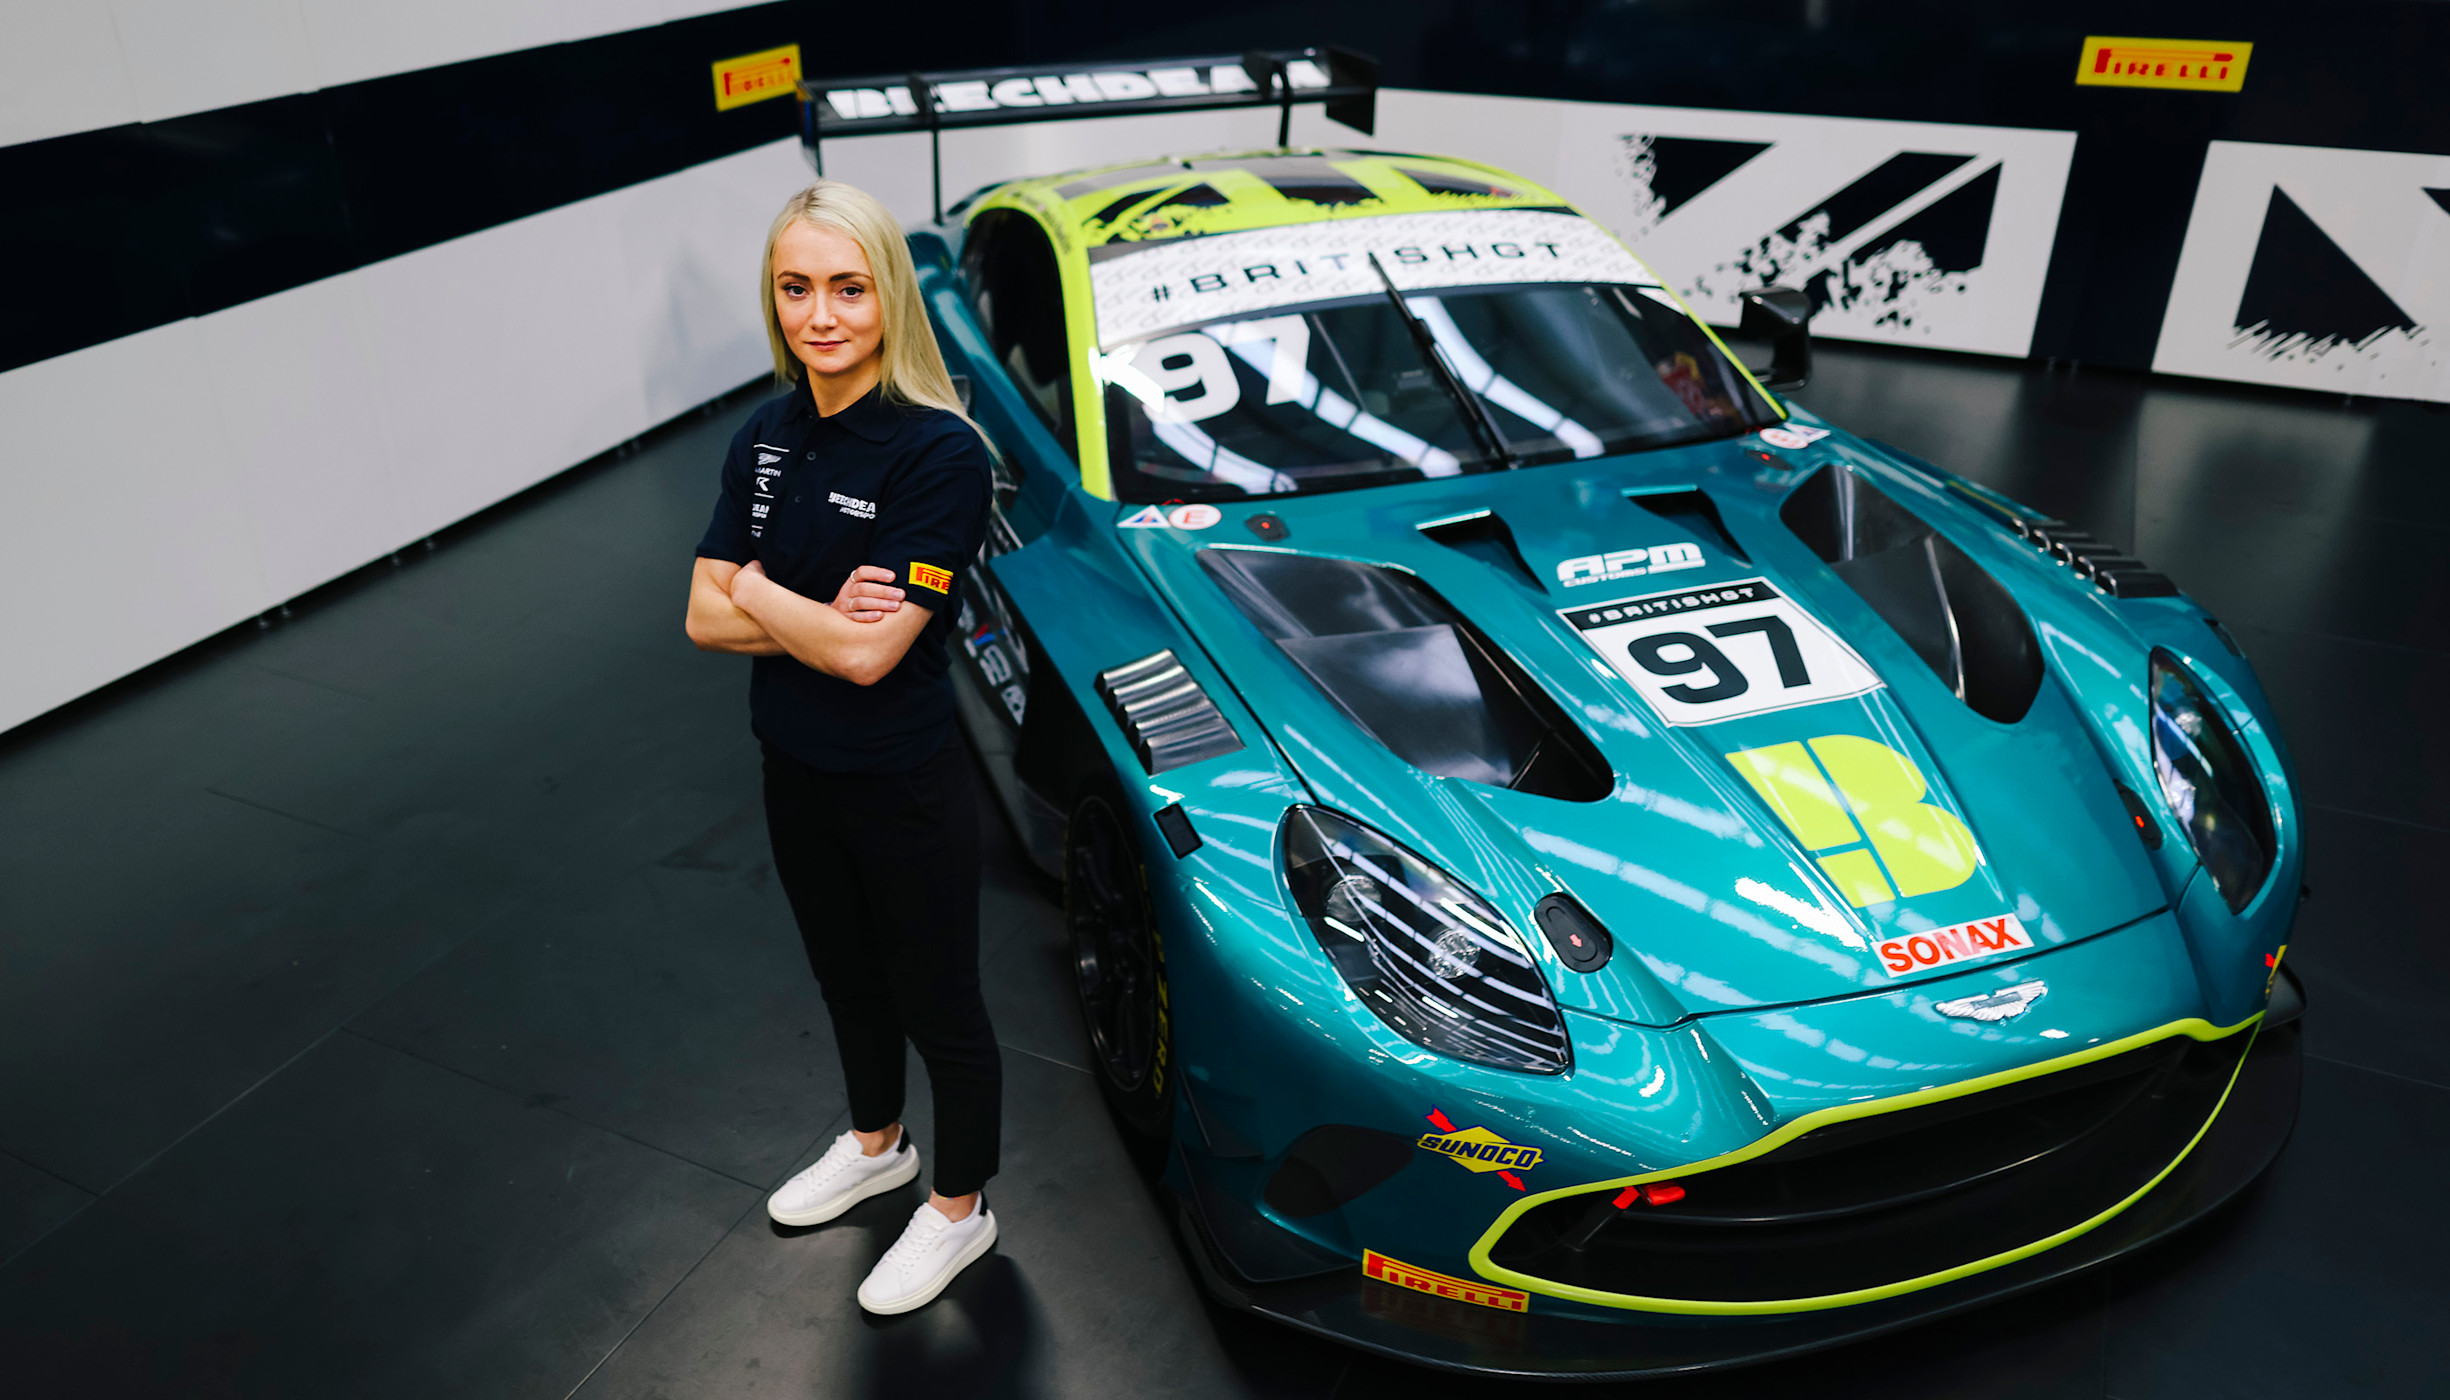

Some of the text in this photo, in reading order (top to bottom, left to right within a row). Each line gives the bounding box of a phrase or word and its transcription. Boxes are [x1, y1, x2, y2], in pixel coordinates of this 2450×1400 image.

[2094, 47, 2234, 80] PIRELLI
[1150, 242, 1560, 303] #BRITSHGT
[1130, 313, 1311, 424] 97
[1557, 542, 1706, 582] APM
[1588, 586, 1756, 625] #BRITISHGT
[1627, 615, 1811, 704] 97
[1880, 918, 2022, 972] SONAX
[1420, 1134, 1538, 1169] SUNOCO
[1366, 1251, 1527, 1312] PIRELLI
